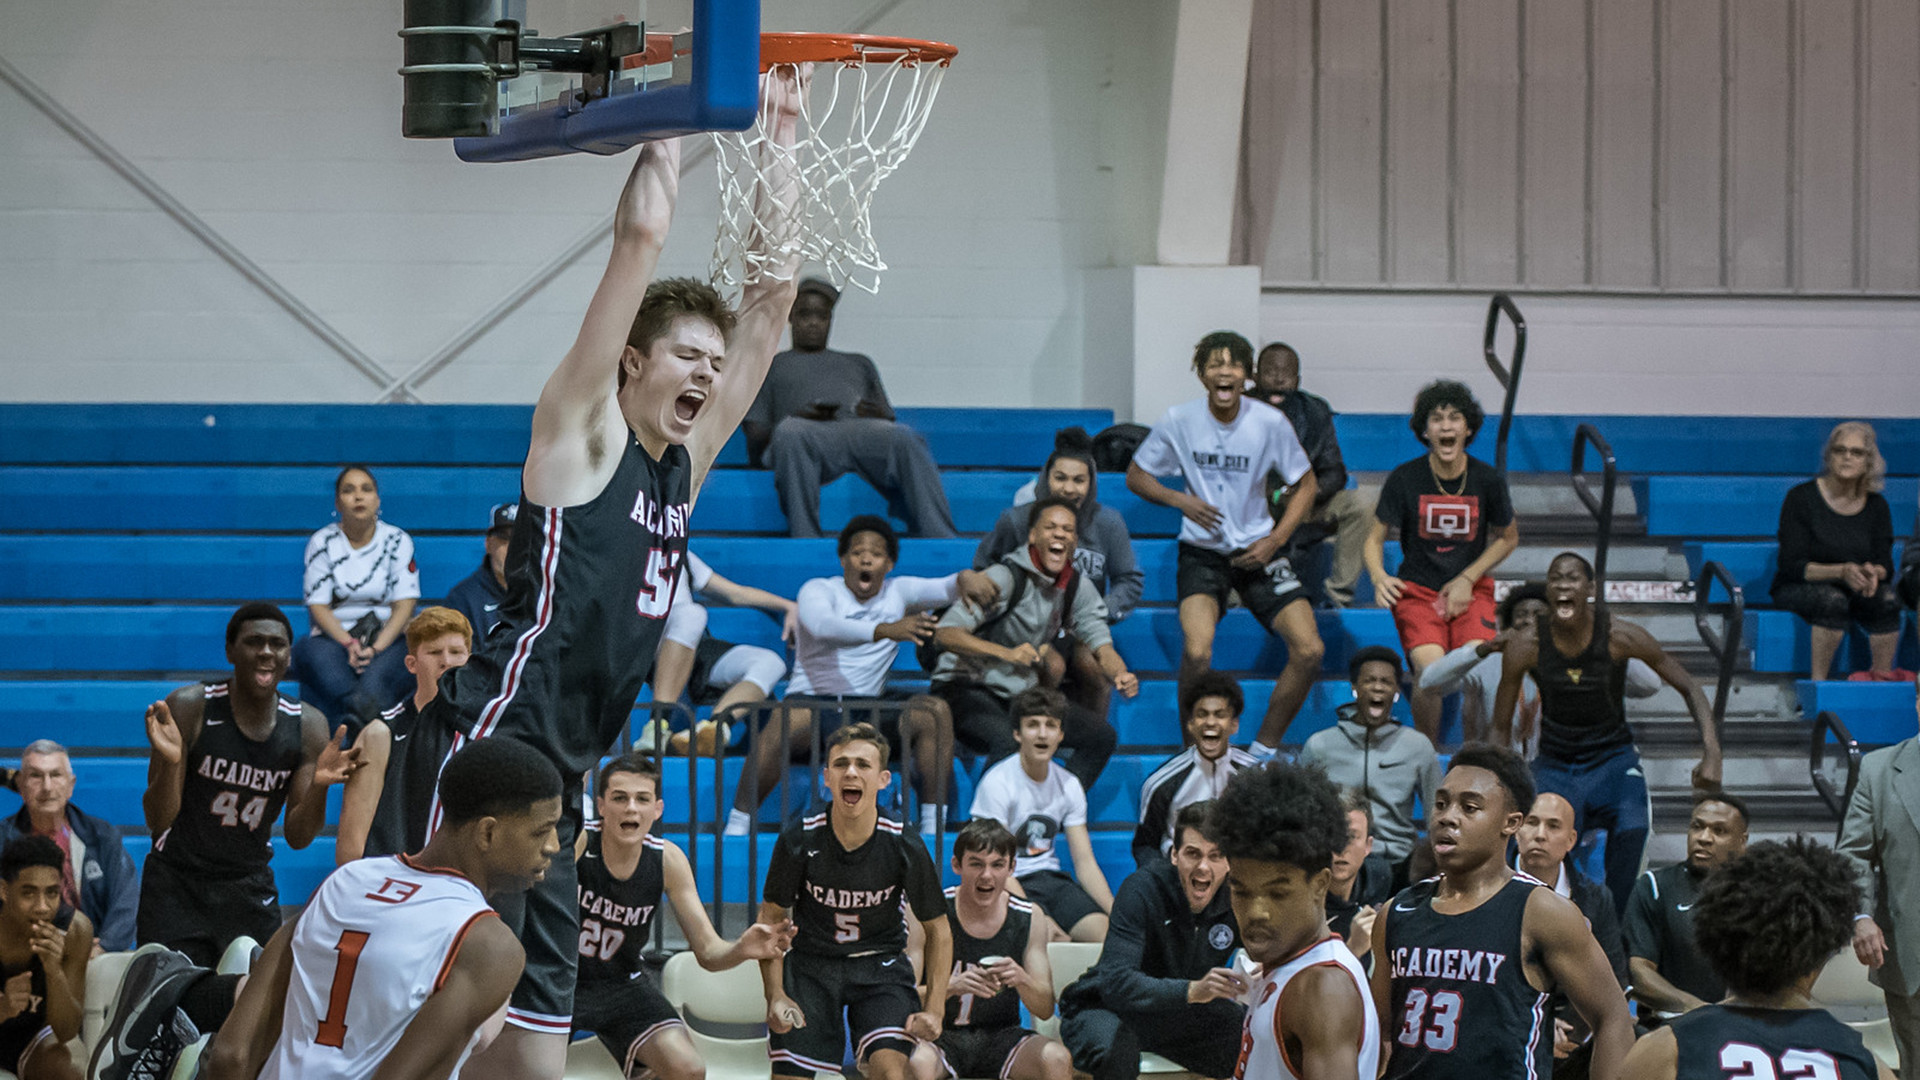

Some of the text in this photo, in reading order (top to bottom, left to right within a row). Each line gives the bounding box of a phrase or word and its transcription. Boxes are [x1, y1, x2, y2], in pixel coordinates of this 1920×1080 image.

[198, 755, 291, 792] ACADEMY
[210, 791, 269, 832] 44
[579, 918, 625, 961] 20
[834, 912, 860, 944] 5
[314, 929, 371, 1050] 1
[1398, 987, 1464, 1053] 33
